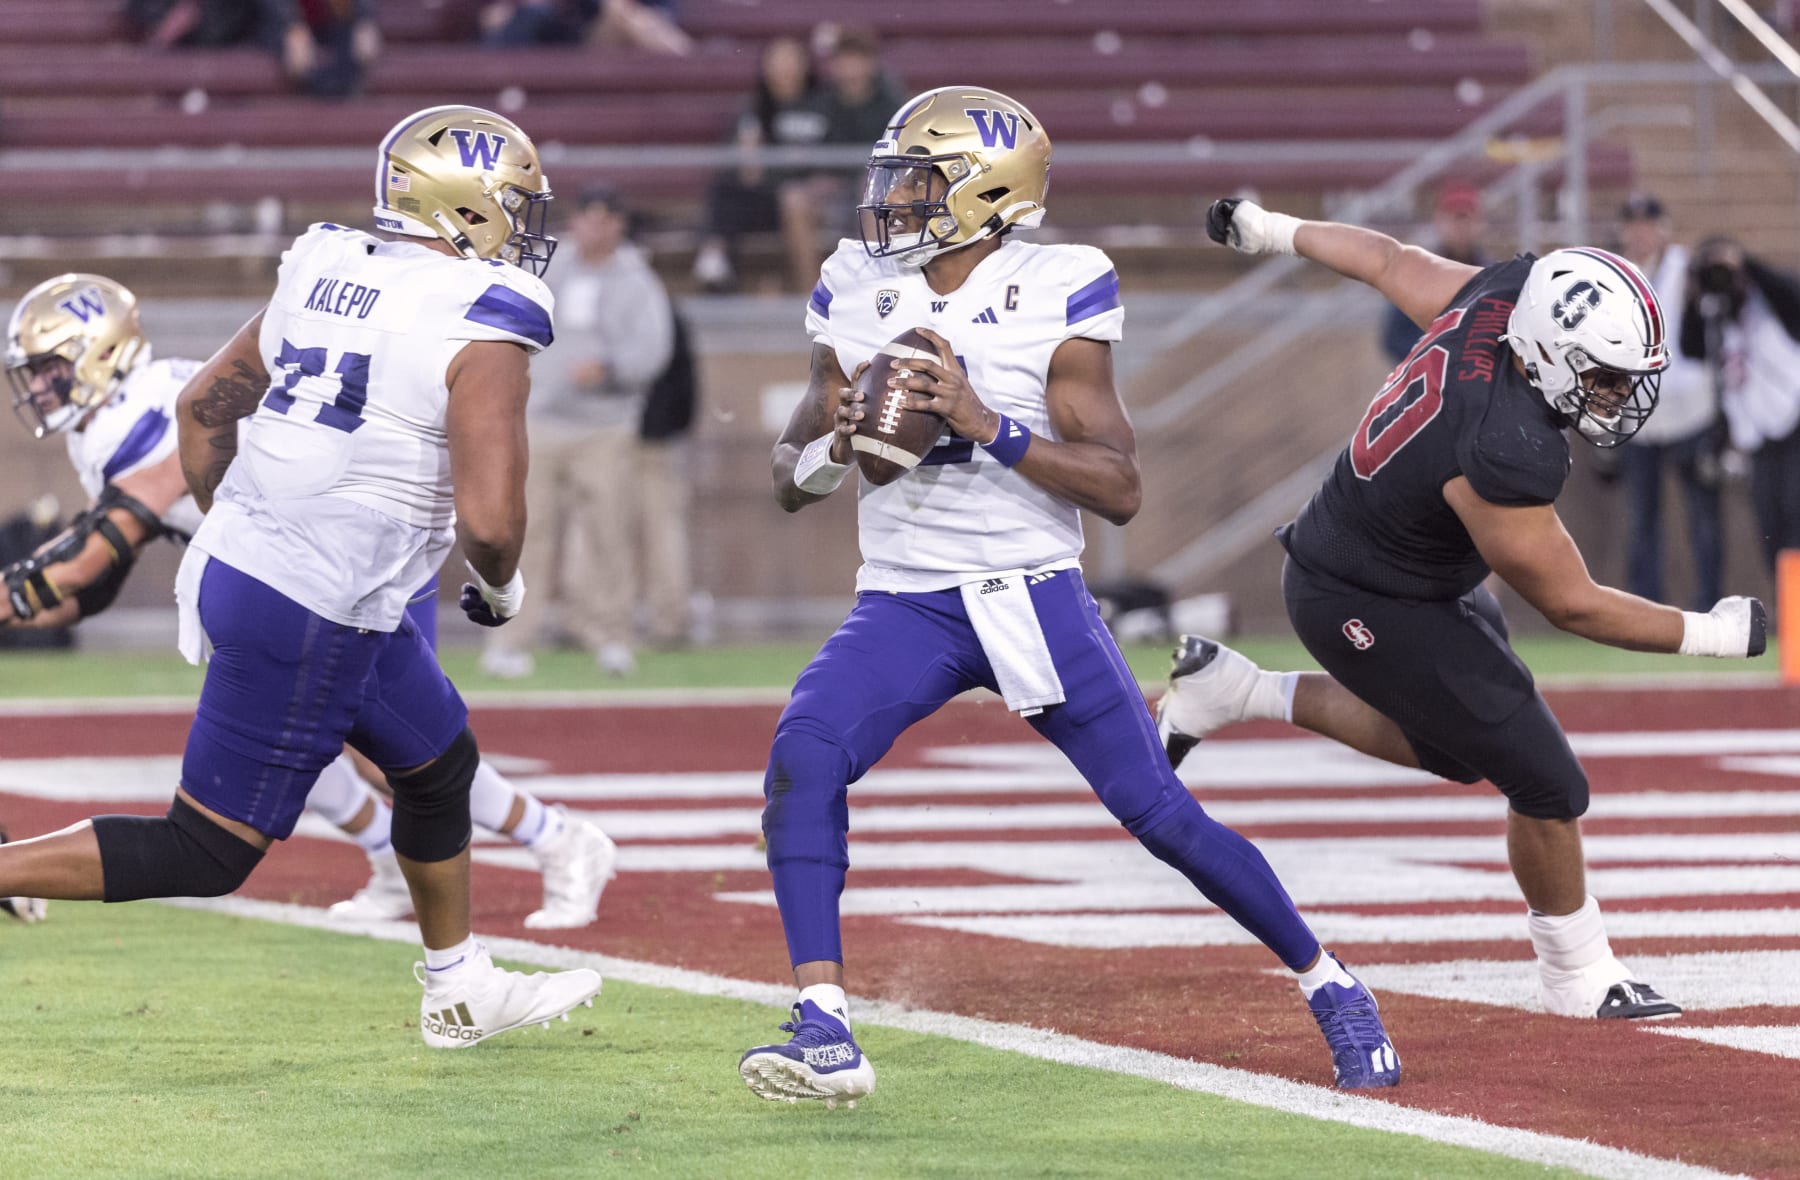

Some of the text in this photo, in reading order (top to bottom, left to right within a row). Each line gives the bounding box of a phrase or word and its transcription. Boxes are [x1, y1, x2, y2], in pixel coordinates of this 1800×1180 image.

[965, 109, 1019, 151] W
[449, 129, 508, 172] W
[57, 285, 106, 324] W
[304, 278, 381, 319] KALEPO
[879, 302, 891, 313] 12
[931, 301, 949, 313] W
[1005, 285, 1019, 311] C
[1458, 298, 1516, 383] PHILLIPS
[263, 337, 372, 434] 71
[980, 583, 1010, 595] adidas
[423, 1015, 483, 1041] adidas
